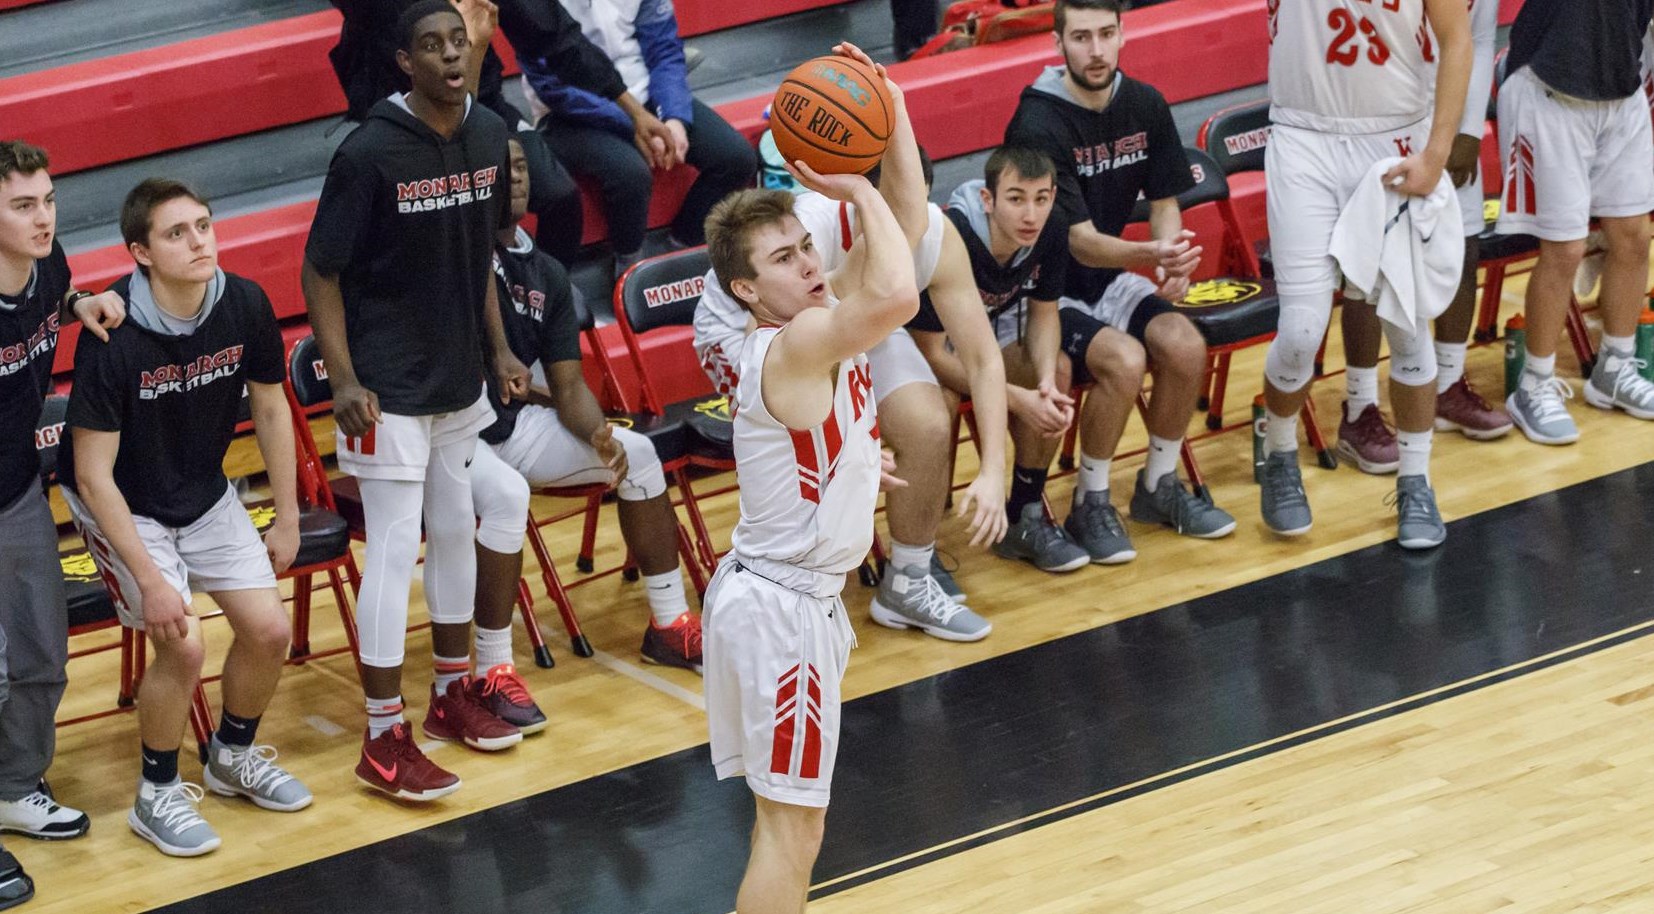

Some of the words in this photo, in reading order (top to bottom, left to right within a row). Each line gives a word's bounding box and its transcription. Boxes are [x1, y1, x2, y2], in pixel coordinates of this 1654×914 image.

[1326, 7, 1390, 67] 23
[780, 91, 811, 123] THE
[807, 106, 853, 147] ROCK
[1224, 125, 1272, 156] MONA
[397, 165, 498, 202] MONARCH
[643, 275, 705, 309] MONAR
[140, 344, 244, 389] MONARCH
